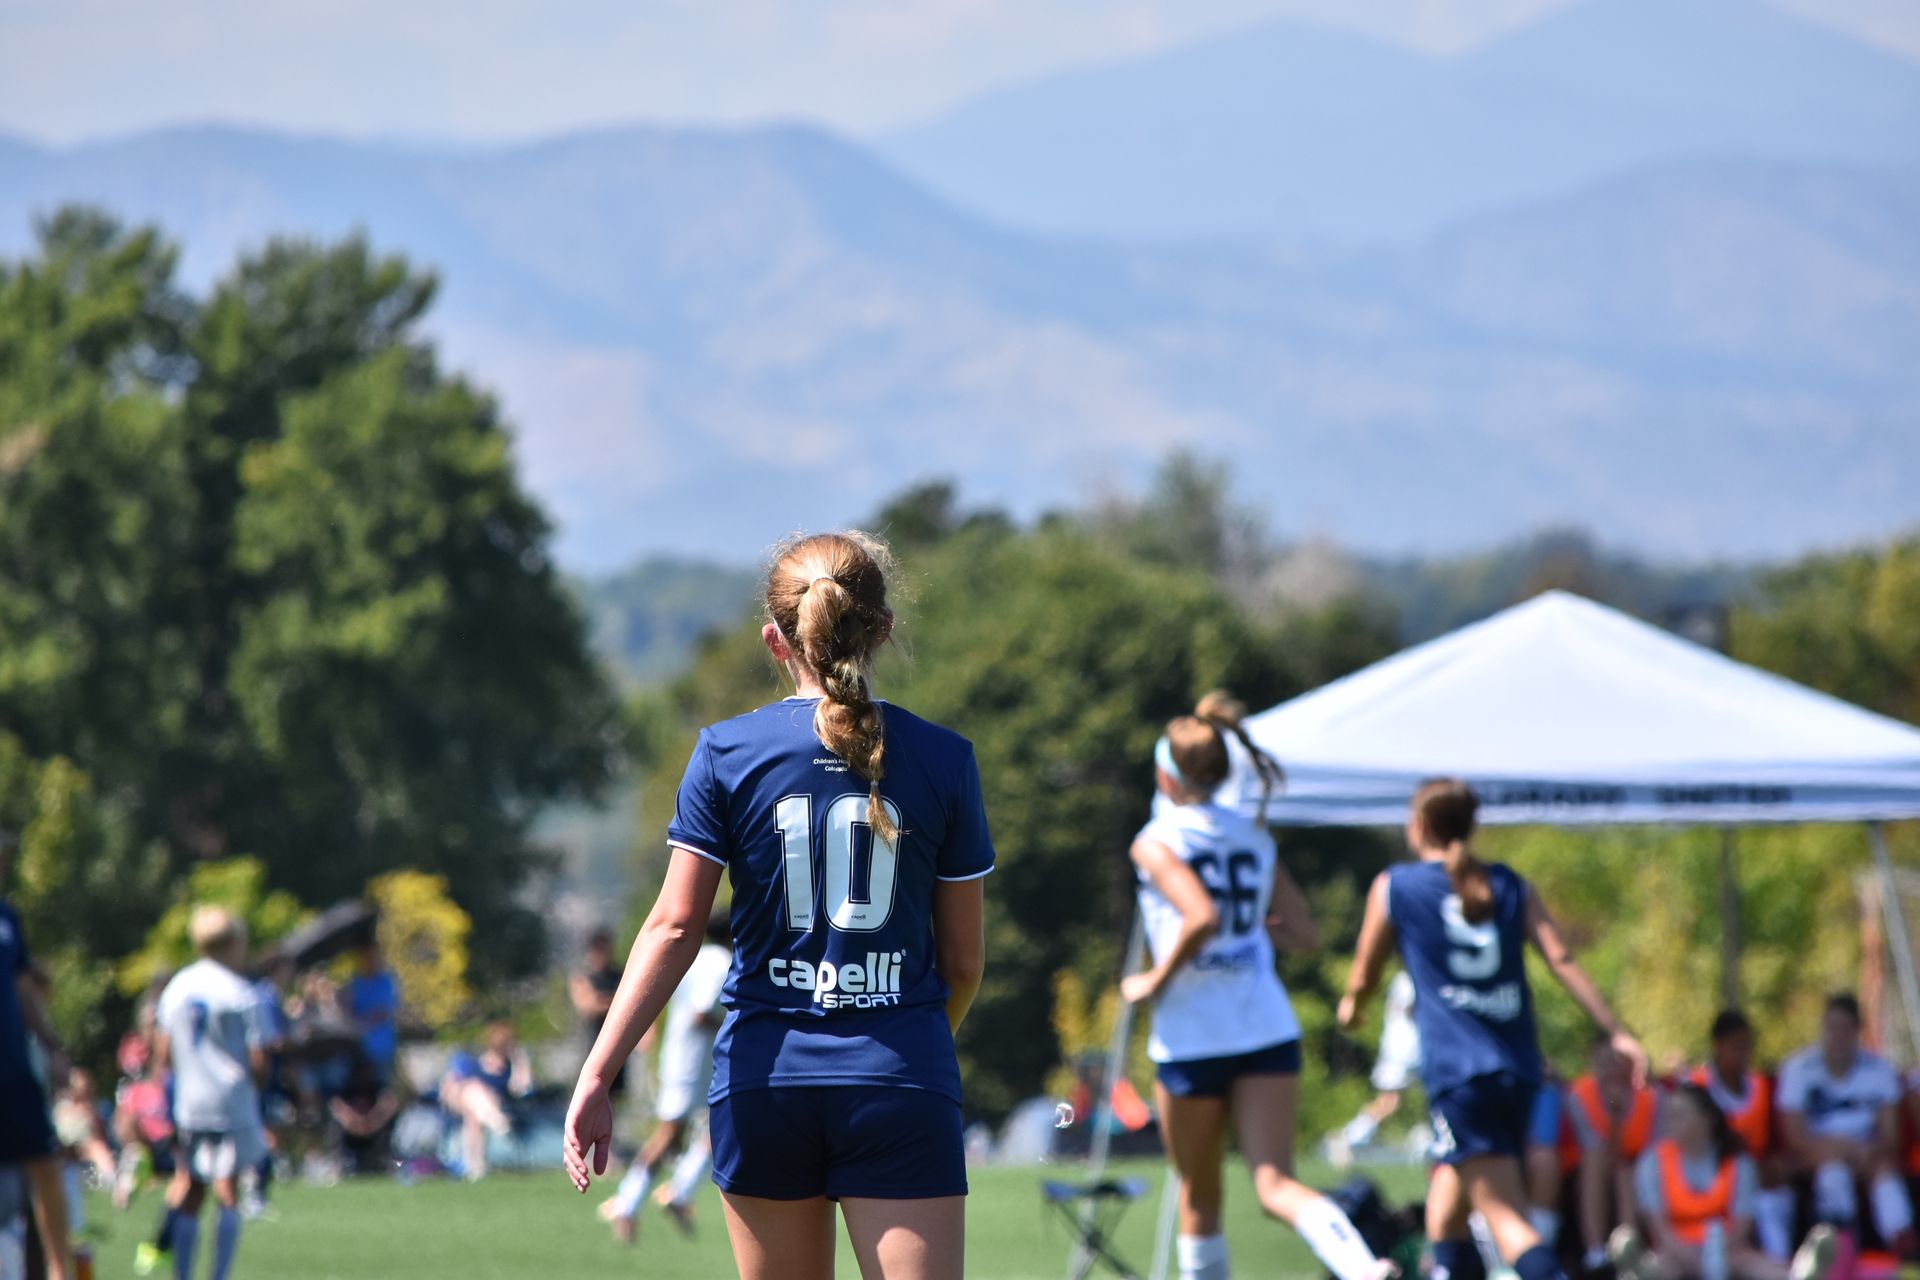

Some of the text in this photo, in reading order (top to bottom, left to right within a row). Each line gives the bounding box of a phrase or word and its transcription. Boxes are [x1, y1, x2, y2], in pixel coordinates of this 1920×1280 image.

[773, 793, 902, 932] 10
[768, 951, 902, 1003] capelli
[822, 993, 902, 1009] SPORT
